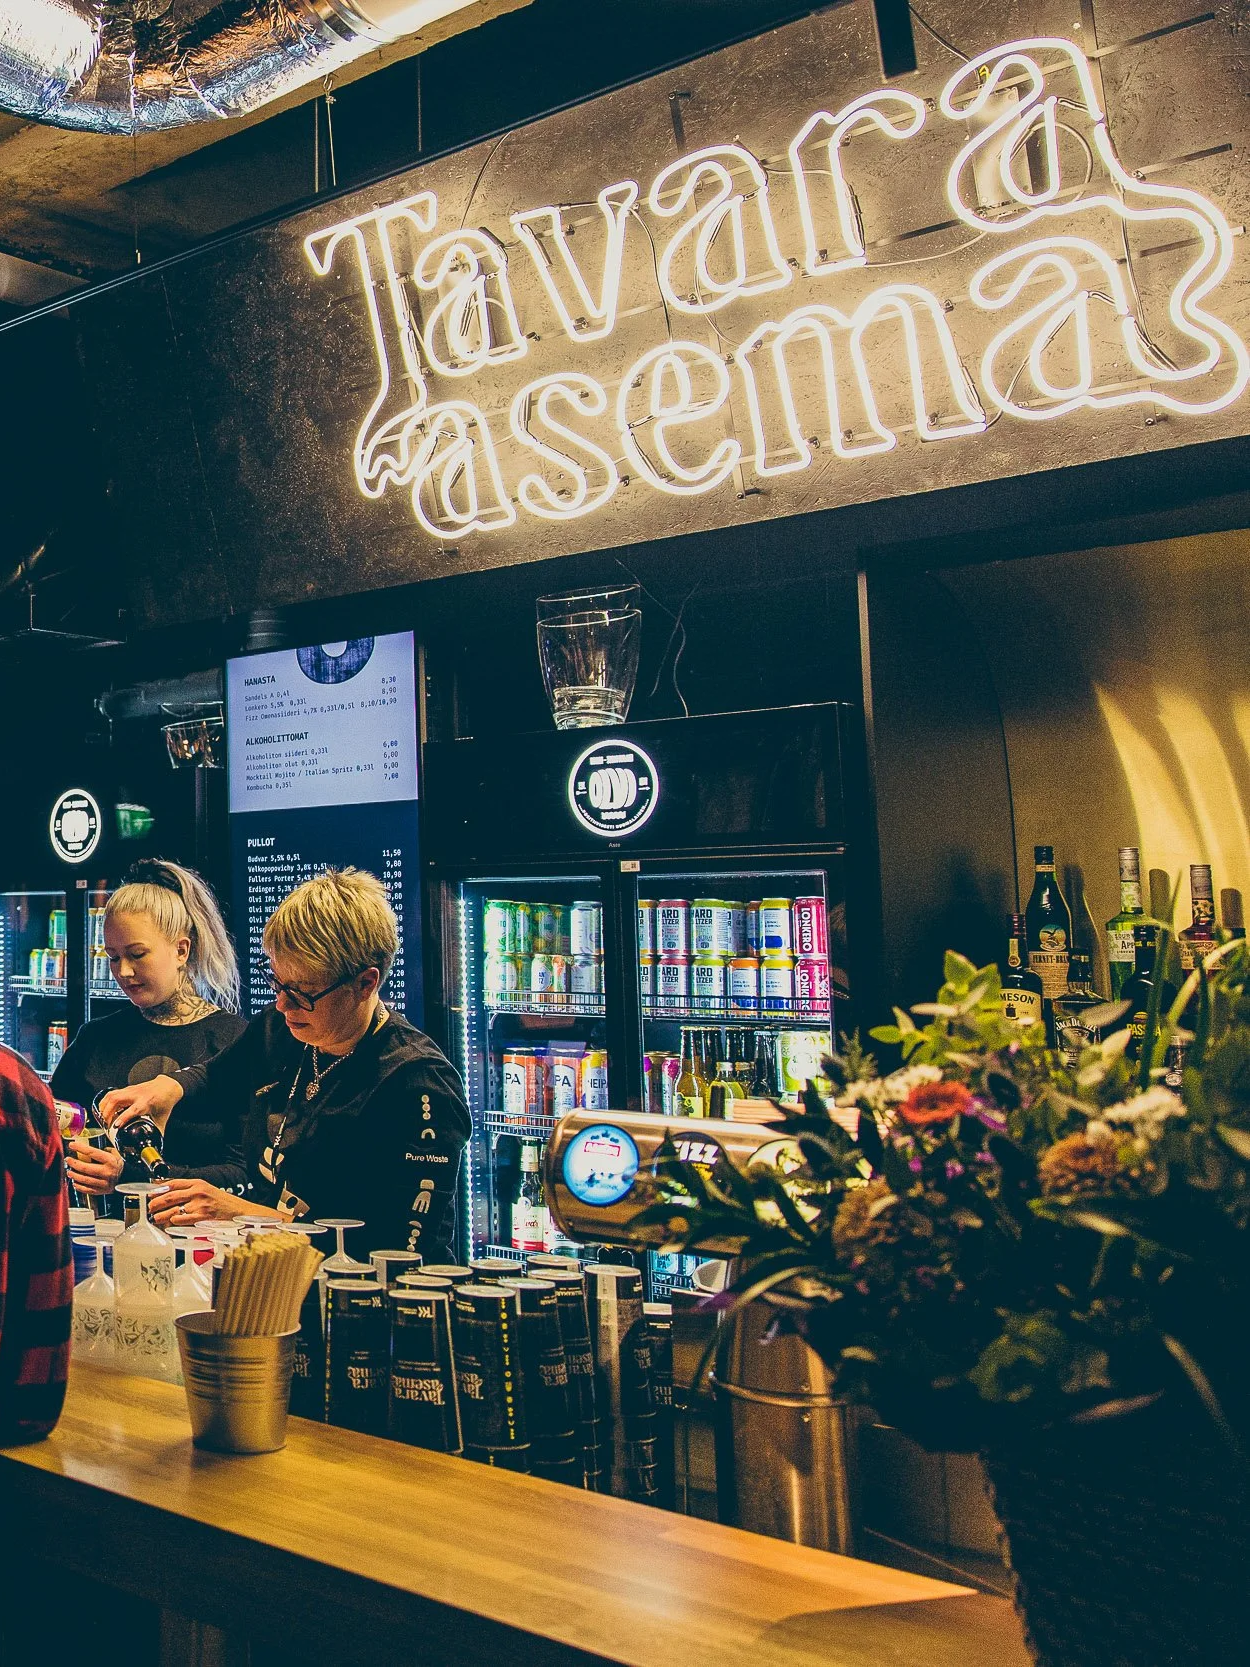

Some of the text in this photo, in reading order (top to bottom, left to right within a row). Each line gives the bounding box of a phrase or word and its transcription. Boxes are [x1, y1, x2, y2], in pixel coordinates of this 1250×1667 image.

[304, 36, 1130, 400] Tavara
[390, 236, 1230, 540] asema
[244, 676, 276, 686] HANASTA
[245, 692, 268, 702] Sandels
[382, 676, 396, 684] 8,30
[245, 704, 268, 712] Lonkero
[270, 702, 284, 710] 5,5%
[261, 709, 300, 720] Omenasiideri
[246, 732, 309, 746] ALKOHOLITTOMAT
[246, 752, 282, 761] Alkoholiton
[284, 749, 308, 757] siideri
[383, 740, 398, 748] 6,00
[246, 762, 282, 771] Alkoholiton
[384, 751, 398, 759] 6,00
[275, 772, 295, 780] Mojito
[305, 768, 329, 776] Italian
[332, 766, 353, 774] Spritz
[248, 838, 275, 848] PULLOT
[271, 854, 284, 862] 5,5%
[287, 854, 300, 862] 0,5l
[382, 849, 401, 857] 11,50
[248, 885, 275, 893] Erdinger
[801, 908, 812, 952] LONKERO
[1032, 954, 1068, 963] FERNET-BRA
[999, 992, 1035, 1005] MESON
[405, 1152, 449, 1163] Pure Waste
[391, 1375, 444, 1391] asema
[395, 1388, 445, 1405] Tavara
